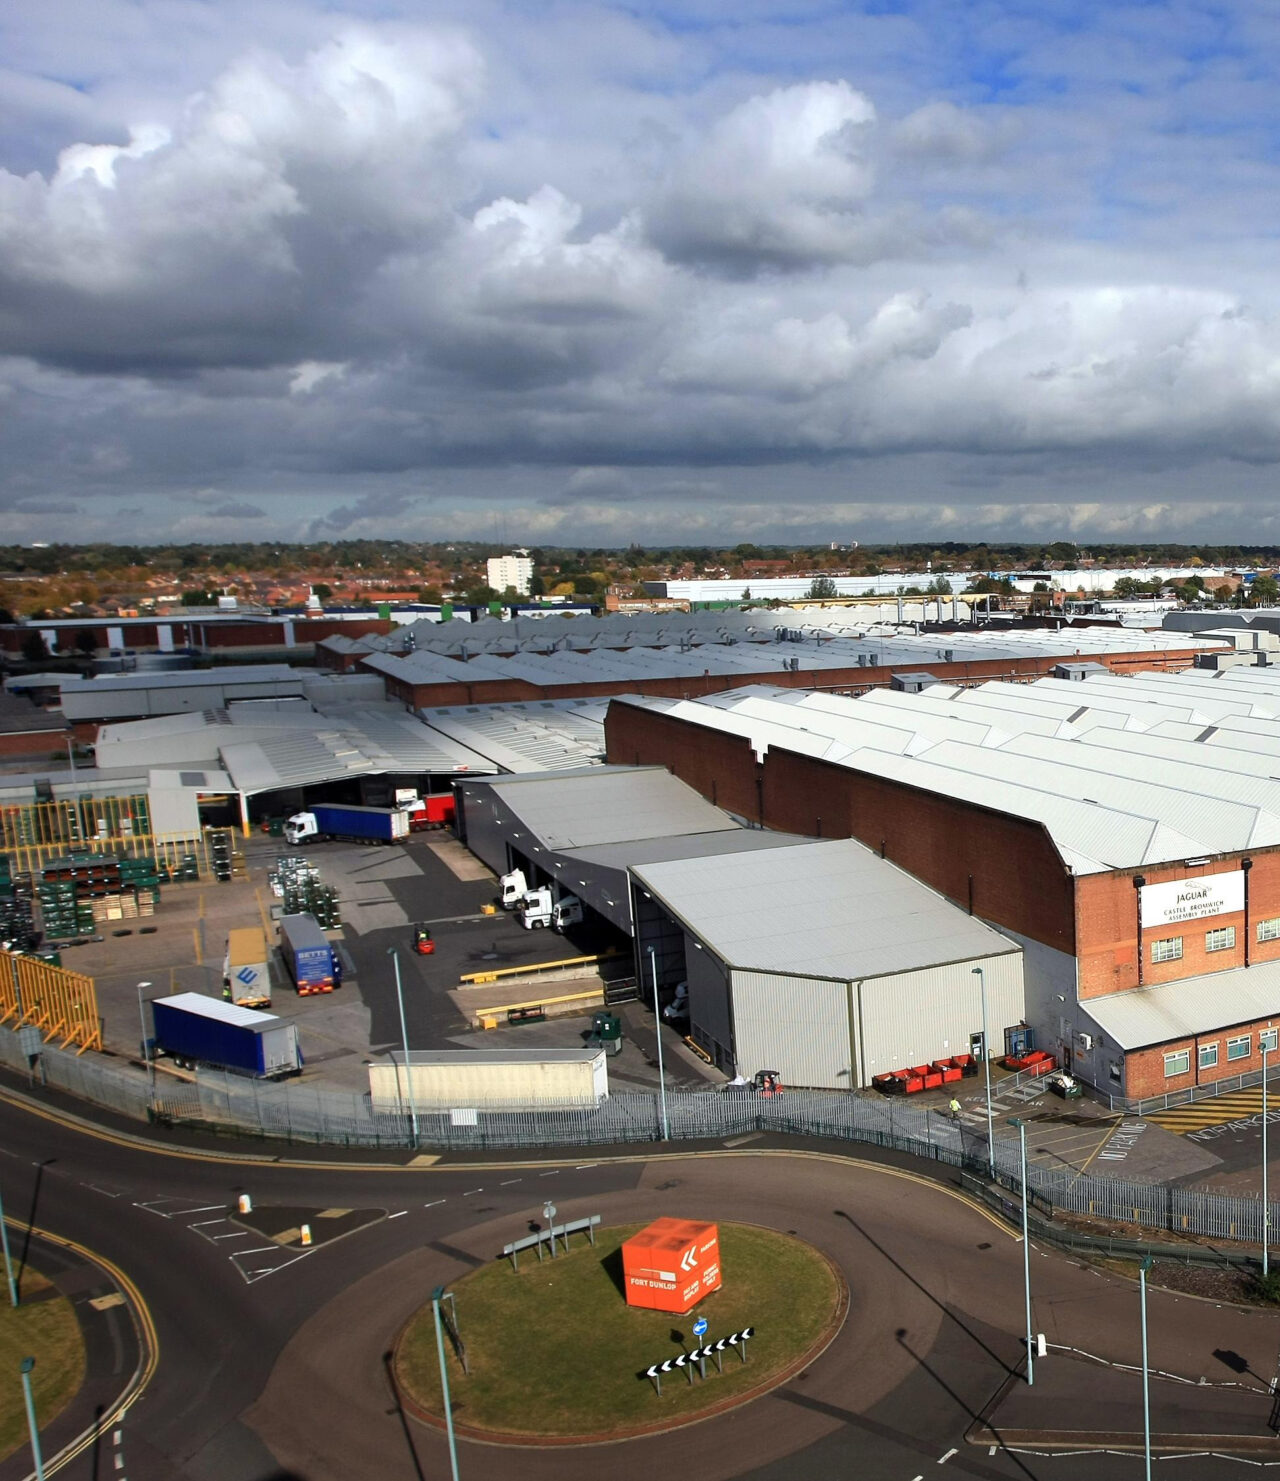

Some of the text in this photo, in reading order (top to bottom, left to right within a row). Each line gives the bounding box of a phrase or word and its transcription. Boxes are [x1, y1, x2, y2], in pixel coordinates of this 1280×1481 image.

[1177, 890, 1207, 904] JAGUAR
[1164, 900, 1224, 915] CASTLE BROMWICH
[1169, 907, 1220, 920] ASSEMBLY PLANT
[1097, 1122, 1147, 1160] NO PARKING
[1185, 1128, 1220, 1142] NO
[630, 1278, 676, 1290] FORT DUNLOP
